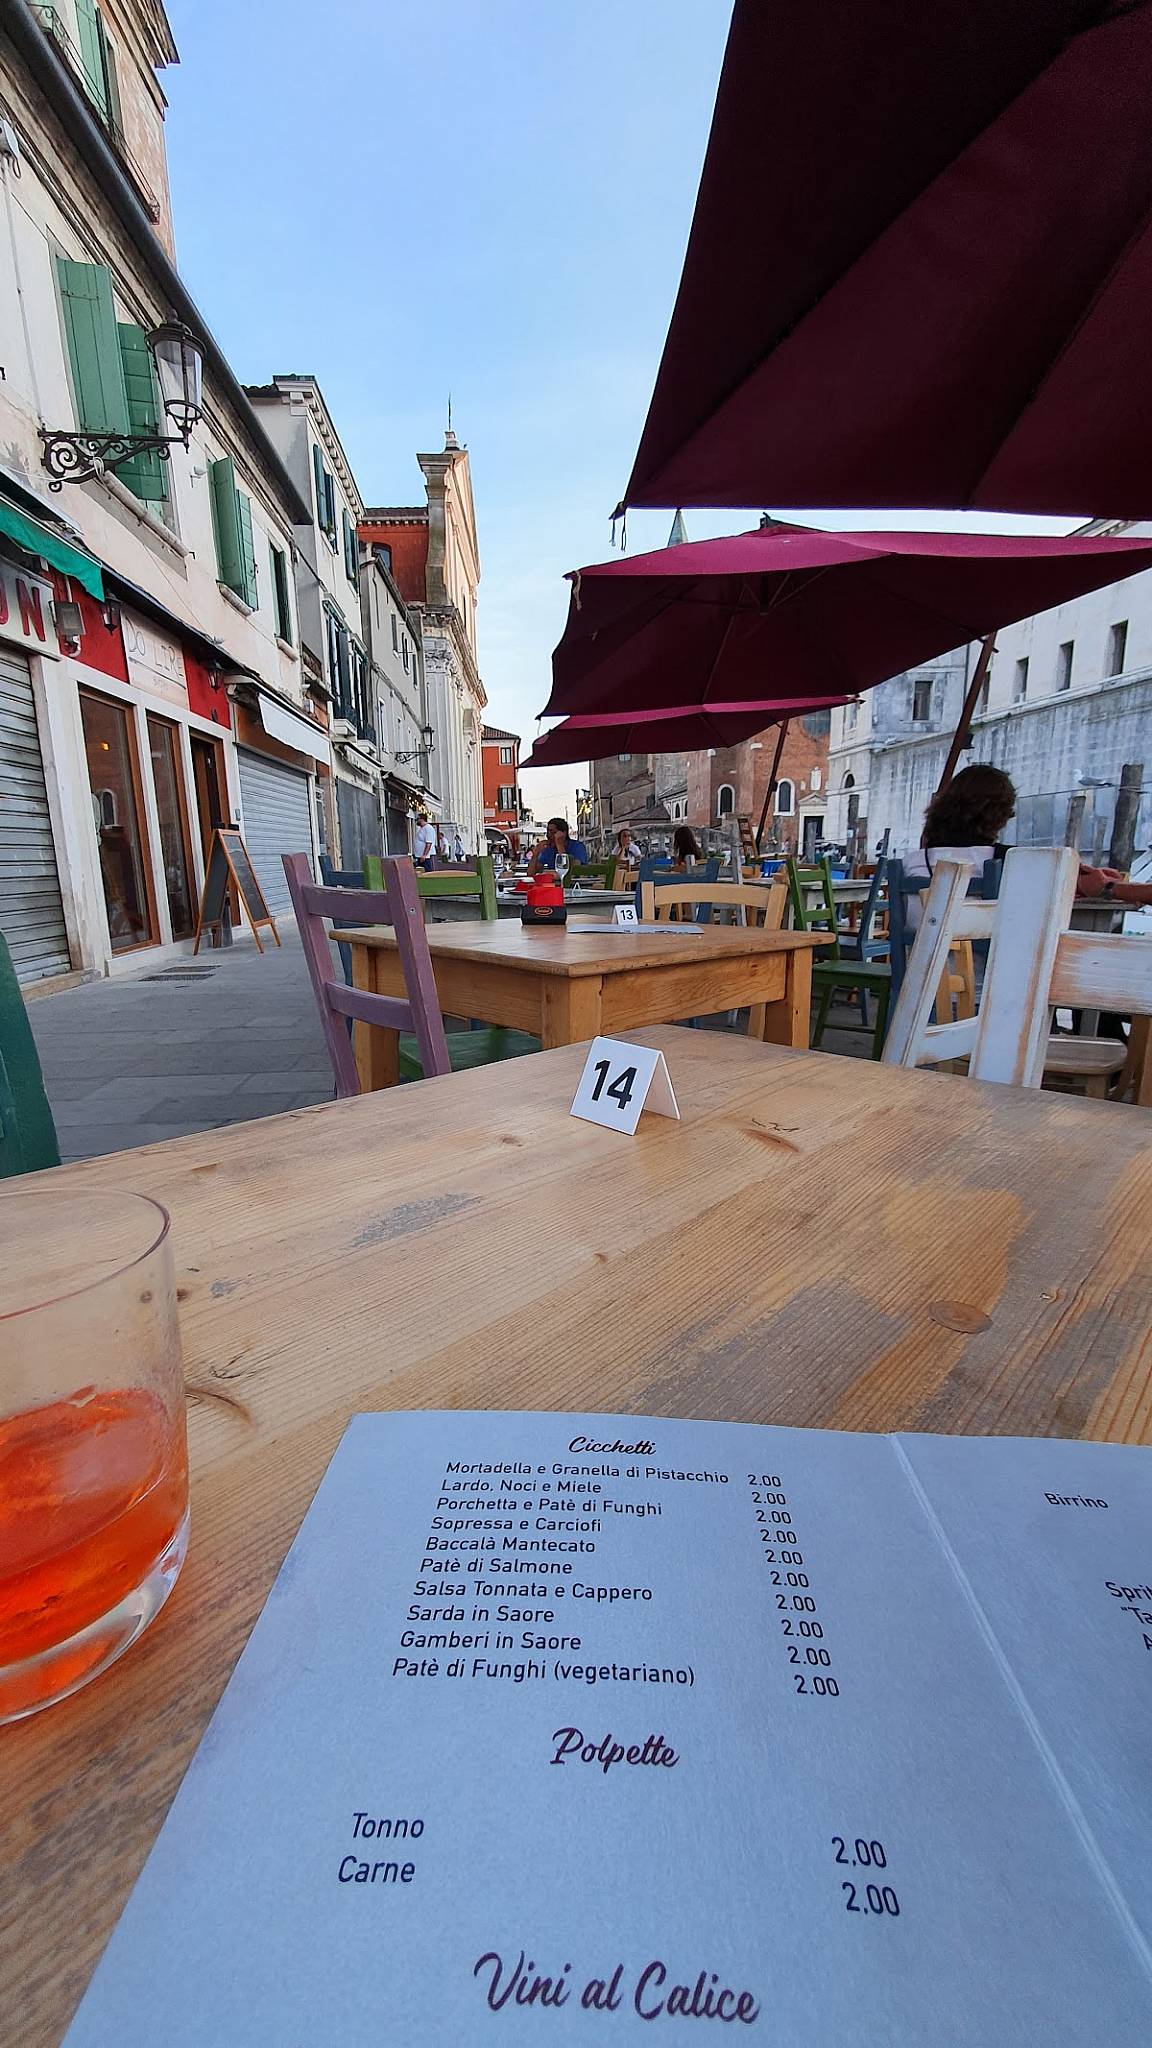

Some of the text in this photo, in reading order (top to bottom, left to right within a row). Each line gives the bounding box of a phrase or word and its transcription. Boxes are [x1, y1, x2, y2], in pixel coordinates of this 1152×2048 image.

[620, 908, 634, 921] 13
[592, 1060, 637, 1110] 14
[568, 1436, 657, 1456] Cicchetti
[445, 1461, 729, 1484] Mortadella e Granella di Pistacchio
[747, 1473, 782, 1488] 2.00
[499, 1479, 537, 1492] Noci
[541, 1482, 552, 1492] e
[557, 1480, 602, 1494] Miele
[436, 1497, 662, 1518] Porchetta e Patè di Funghi
[751, 1491, 787, 1506] 2.00
[1043, 1492, 1109, 1509] Birrino
[430, 1516, 601, 1534] Sopressa e Carciofi
[755, 1509, 792, 1525] 2.00
[425, 1536, 596, 1553] Baccalà Mantecato
[759, 1528, 798, 1545] 2.00
[419, 1557, 573, 1575] Patè di Salmone
[764, 1548, 804, 1566] 2.00
[769, 1570, 810, 1588] 2.00
[412, 1580, 653, 1604] Salsa Tonnata e Cappero
[775, 1593, 817, 1613] 2.00
[406, 1604, 555, 1623] Sarda in Saore
[780, 1618, 824, 1639] 2.00
[400, 1630, 582, 1651] Gamberi in Saore
[786, 1645, 832, 1667] 2.00
[392, 1657, 695, 1688] Patè di Funghi (vegetariano)
[793, 1674, 840, 1697] 2.00
[549, 1727, 681, 1775] Polpette
[352, 1812, 425, 1839] Tonno
[337, 1854, 416, 1884] Carne
[473, 1950, 761, 2025] Vini al Calice
